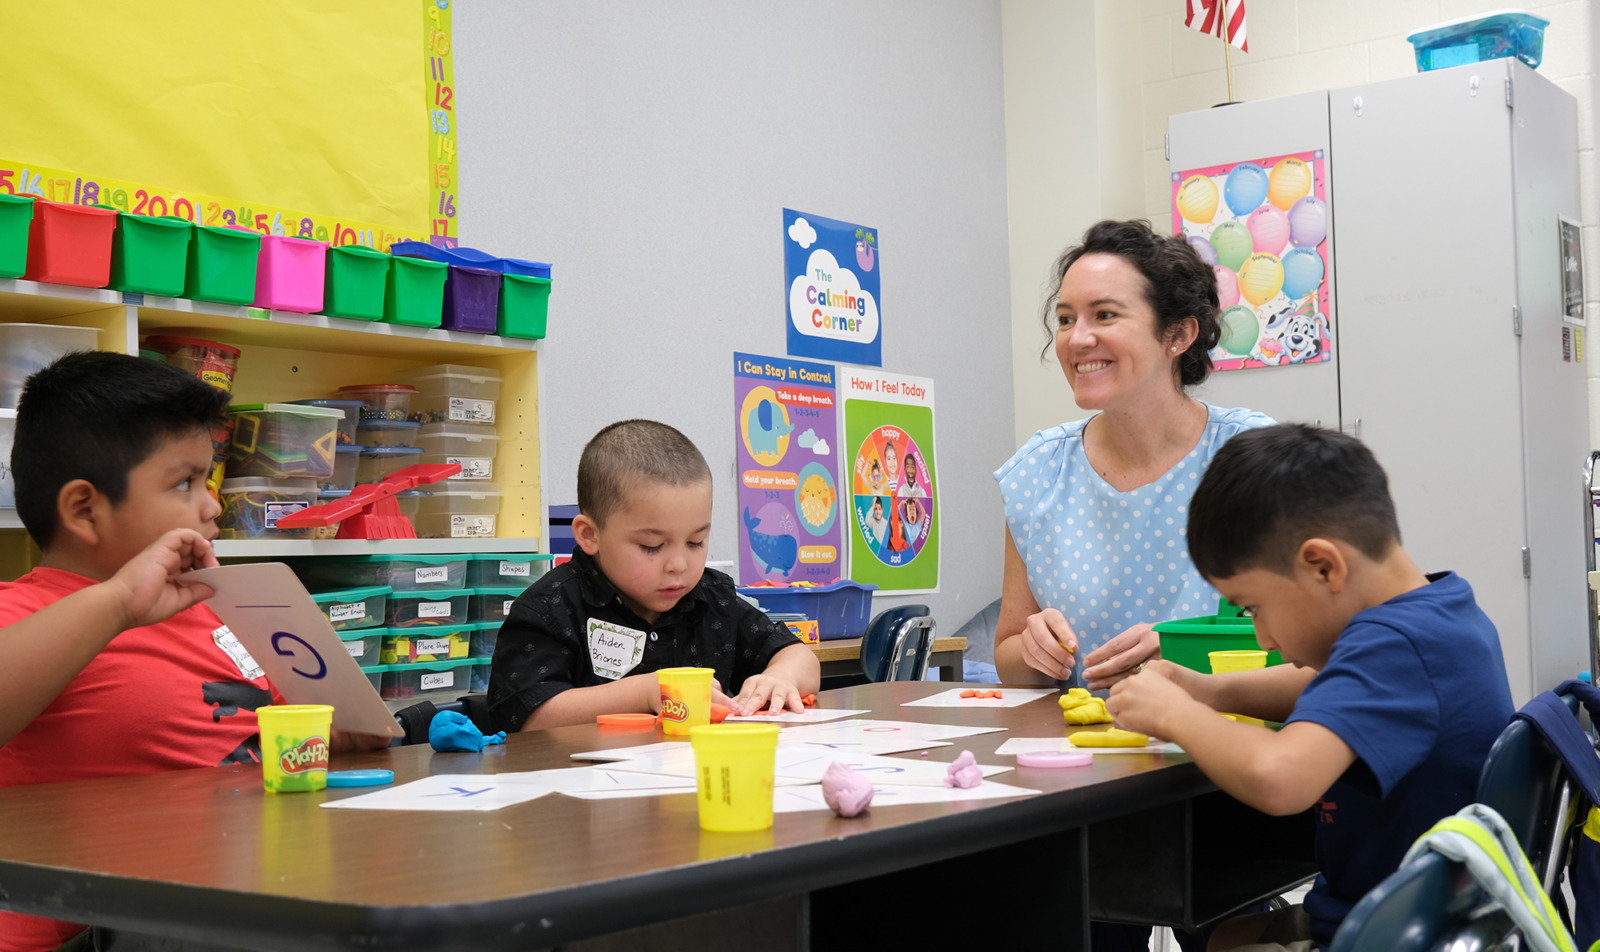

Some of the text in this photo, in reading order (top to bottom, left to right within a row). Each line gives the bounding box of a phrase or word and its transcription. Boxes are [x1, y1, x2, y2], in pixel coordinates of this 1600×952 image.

[428, 5, 441, 30] 9
[429, 28, 450, 56] 10
[430, 56, 444, 81] 11
[435, 82, 453, 110] 12
[431, 108, 450, 134] 13
[437, 135, 456, 163] 14
[433, 163, 451, 188] 15
[19, 169, 45, 198] 16
[48, 178, 71, 203] 17
[74, 177, 100, 206] 18
[104, 187, 129, 213] 19
[132, 189, 168, 217] 20
[255, 214, 271, 236] 5
[272, 212, 285, 237] 6
[299, 217, 314, 239] 8
[333, 223, 357, 247] 10
[439, 191, 456, 217] 16
[433, 219, 448, 237] 17
[815, 268, 833, 282] The
[806, 285, 866, 316] Calming
[812, 308, 863, 332] Corner
[738, 360, 832, 384] I Can Stay in Control
[777, 390, 791, 400] Take
[798, 393, 812, 404] deep
[812, 394, 833, 405] breath.
[851, 376, 926, 401] How I Feel Today
[881, 428, 900, 441] happy
[856, 454, 866, 474] silly
[913, 450, 931, 485] excited
[744, 475, 798, 487] Hold your breath.
[856, 506, 875, 545] worried
[920, 513, 931, 540] upset
[801, 550, 815, 558] Blow
[890, 553, 902, 563] sad
[417, 569, 444, 579] Numbers
[502, 563, 525, 574] Shapes
[597, 632, 626, 650] Aiden
[592, 648, 622, 667] Briones
[423, 675, 444, 686] Cubes
[281, 743, 329, 770] Play-Do
